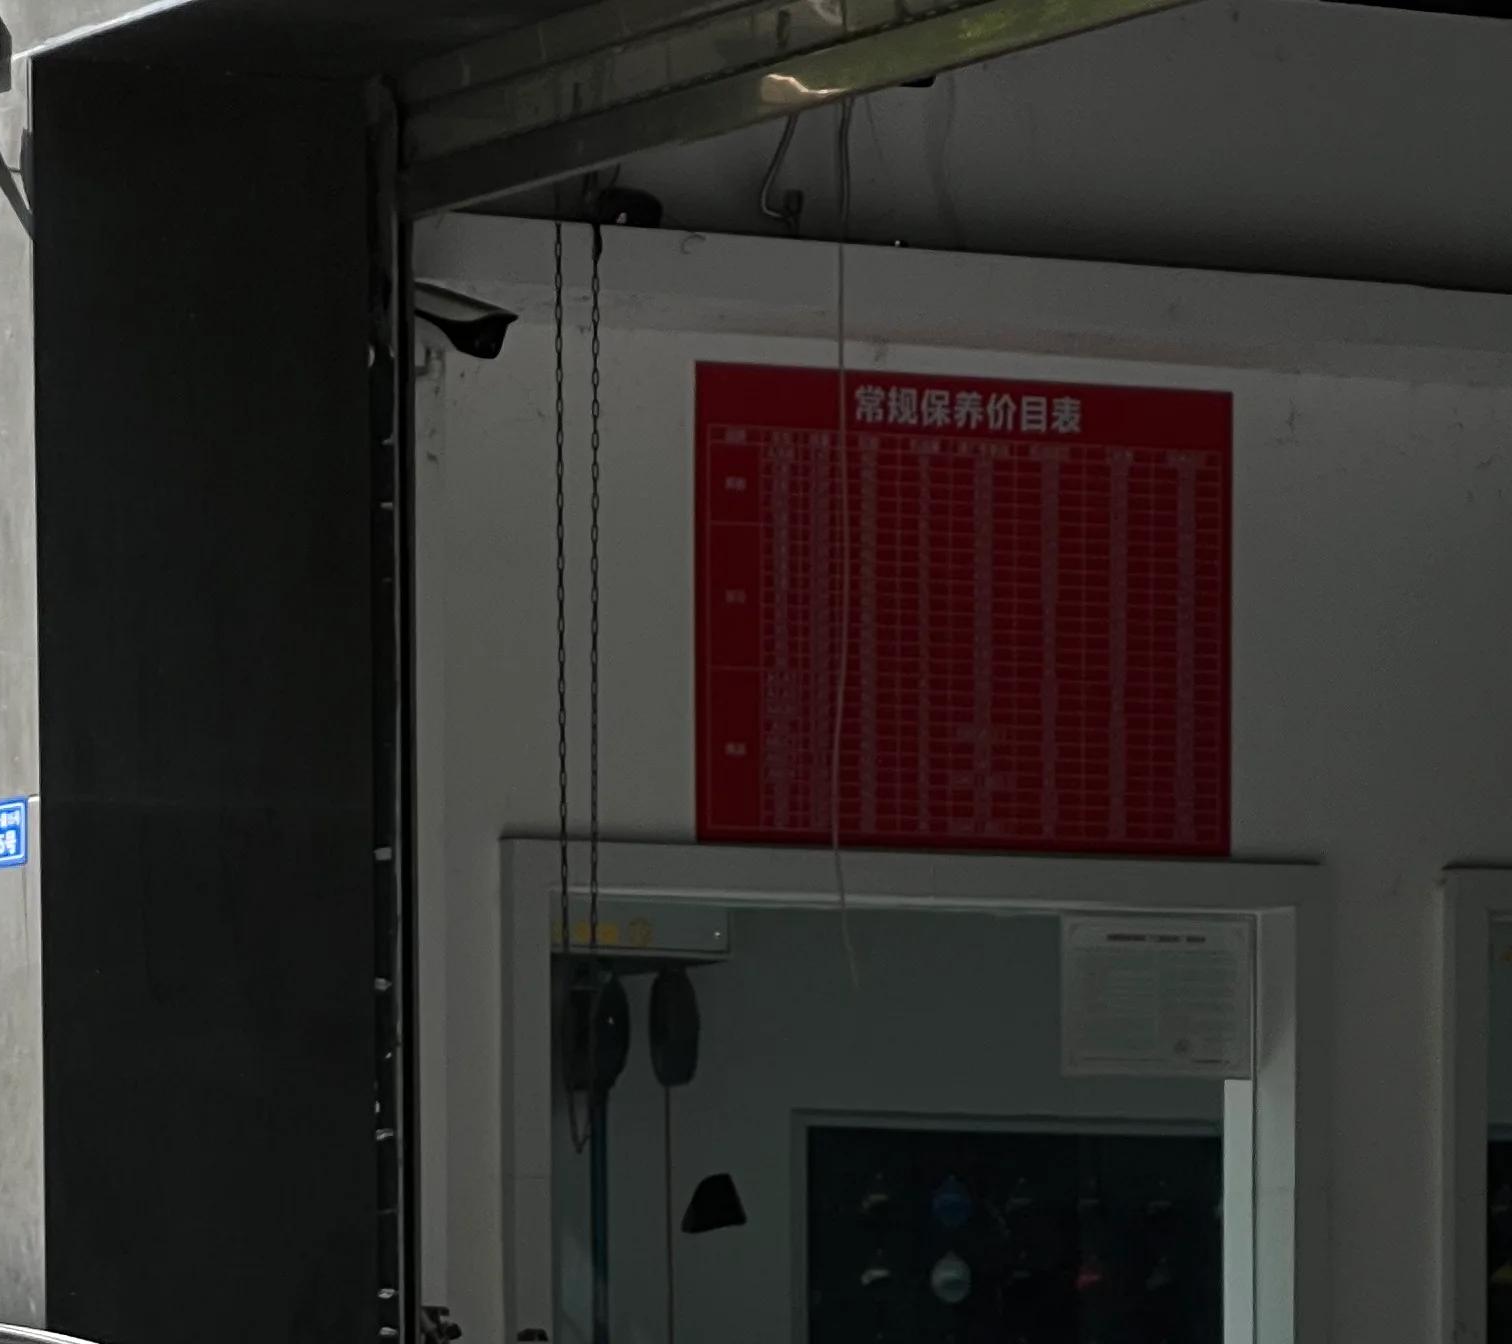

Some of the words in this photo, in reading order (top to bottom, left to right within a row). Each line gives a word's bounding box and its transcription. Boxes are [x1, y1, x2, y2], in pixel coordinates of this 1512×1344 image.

[854, 385, 1081, 434] 常规保养价目表
